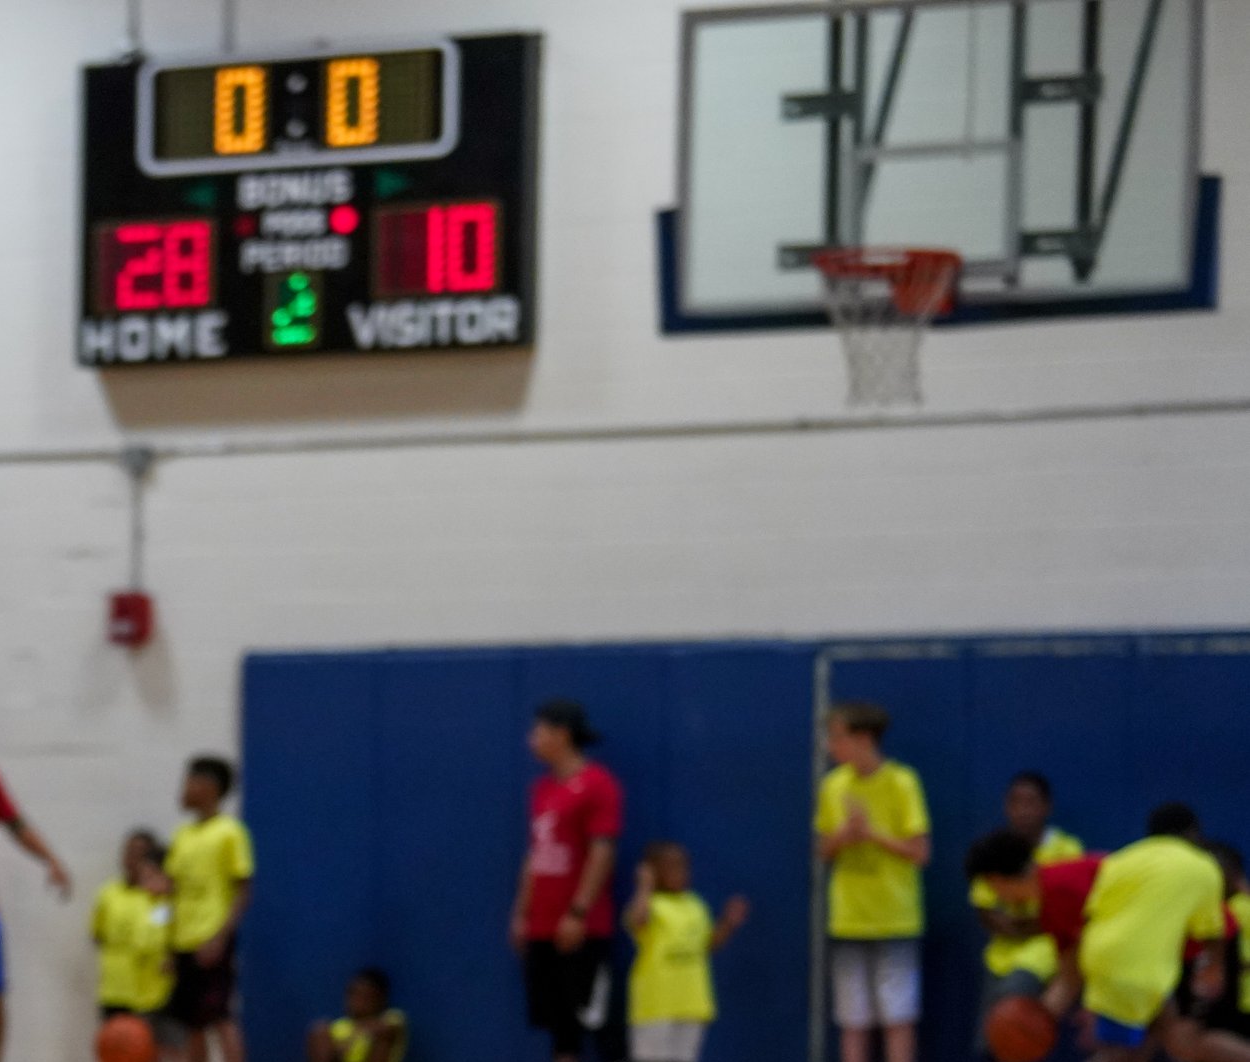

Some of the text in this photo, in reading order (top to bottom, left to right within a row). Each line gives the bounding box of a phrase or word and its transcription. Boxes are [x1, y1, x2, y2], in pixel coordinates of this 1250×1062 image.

[237, 168, 353, 208] BONUS
[115, 219, 211, 310] 28
[240, 237, 349, 272] PERIOD
[426, 203, 497, 293] 10
[81, 310, 228, 362] HOME
[346, 297, 520, 348] VISITOR
